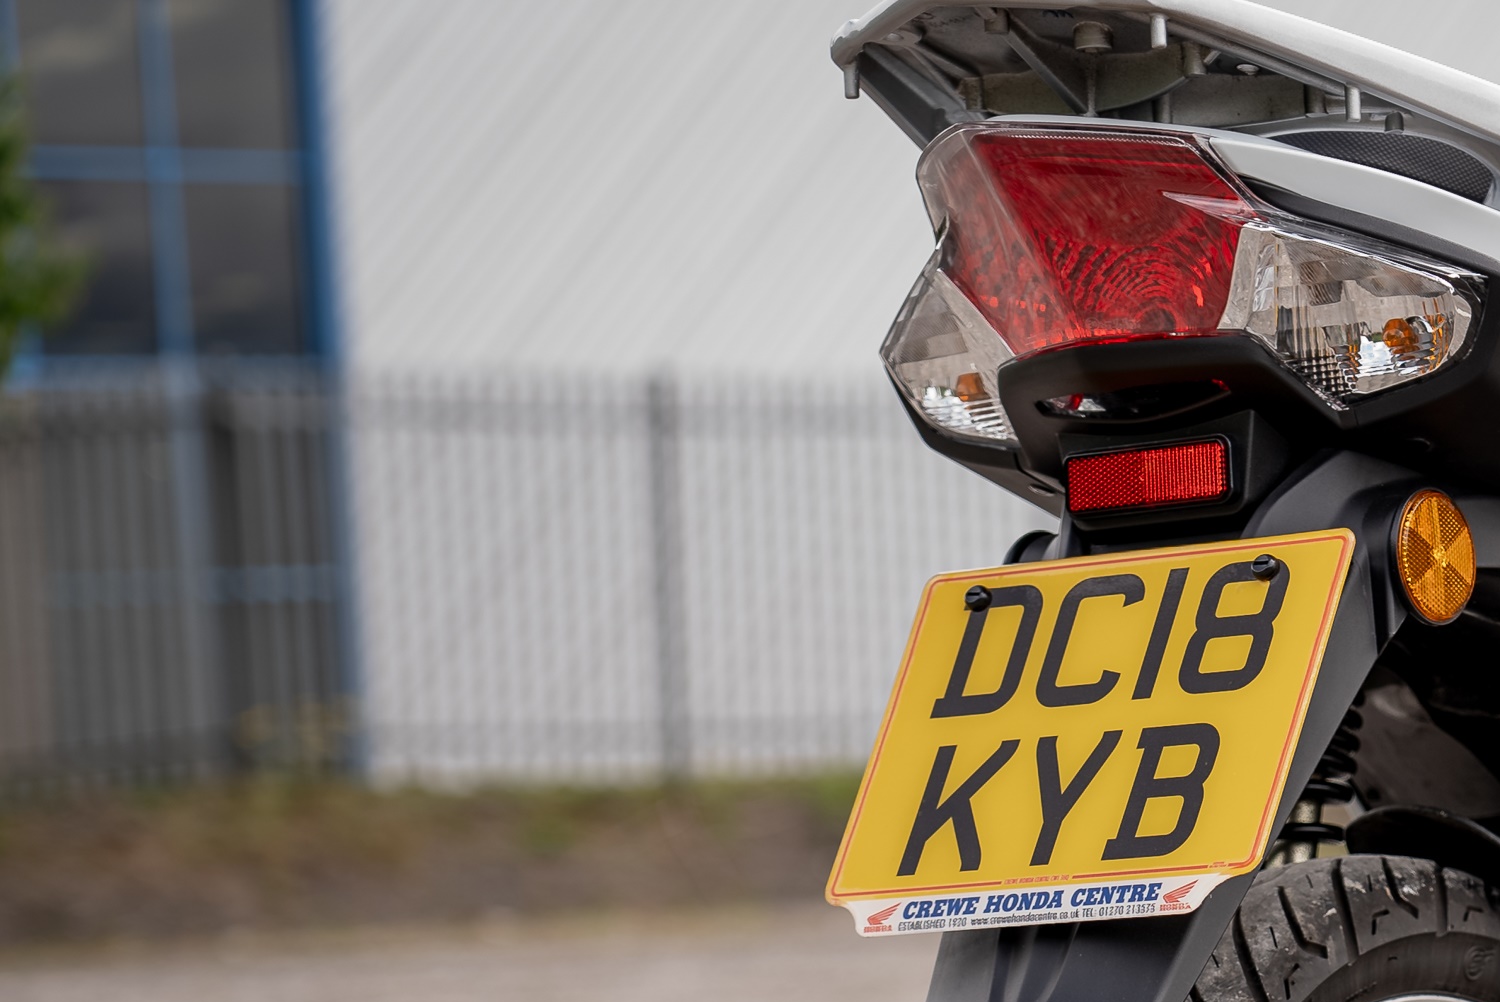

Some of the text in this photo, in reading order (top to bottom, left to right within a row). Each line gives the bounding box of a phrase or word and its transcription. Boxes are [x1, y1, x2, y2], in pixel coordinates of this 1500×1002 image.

[930, 558, 1291, 719] DC18
[896, 722, 1221, 877] KYB
[898, 918, 946, 932] ESTABLISHED
[902, 882, 1163, 920] CREWE HONDA CENTRE
